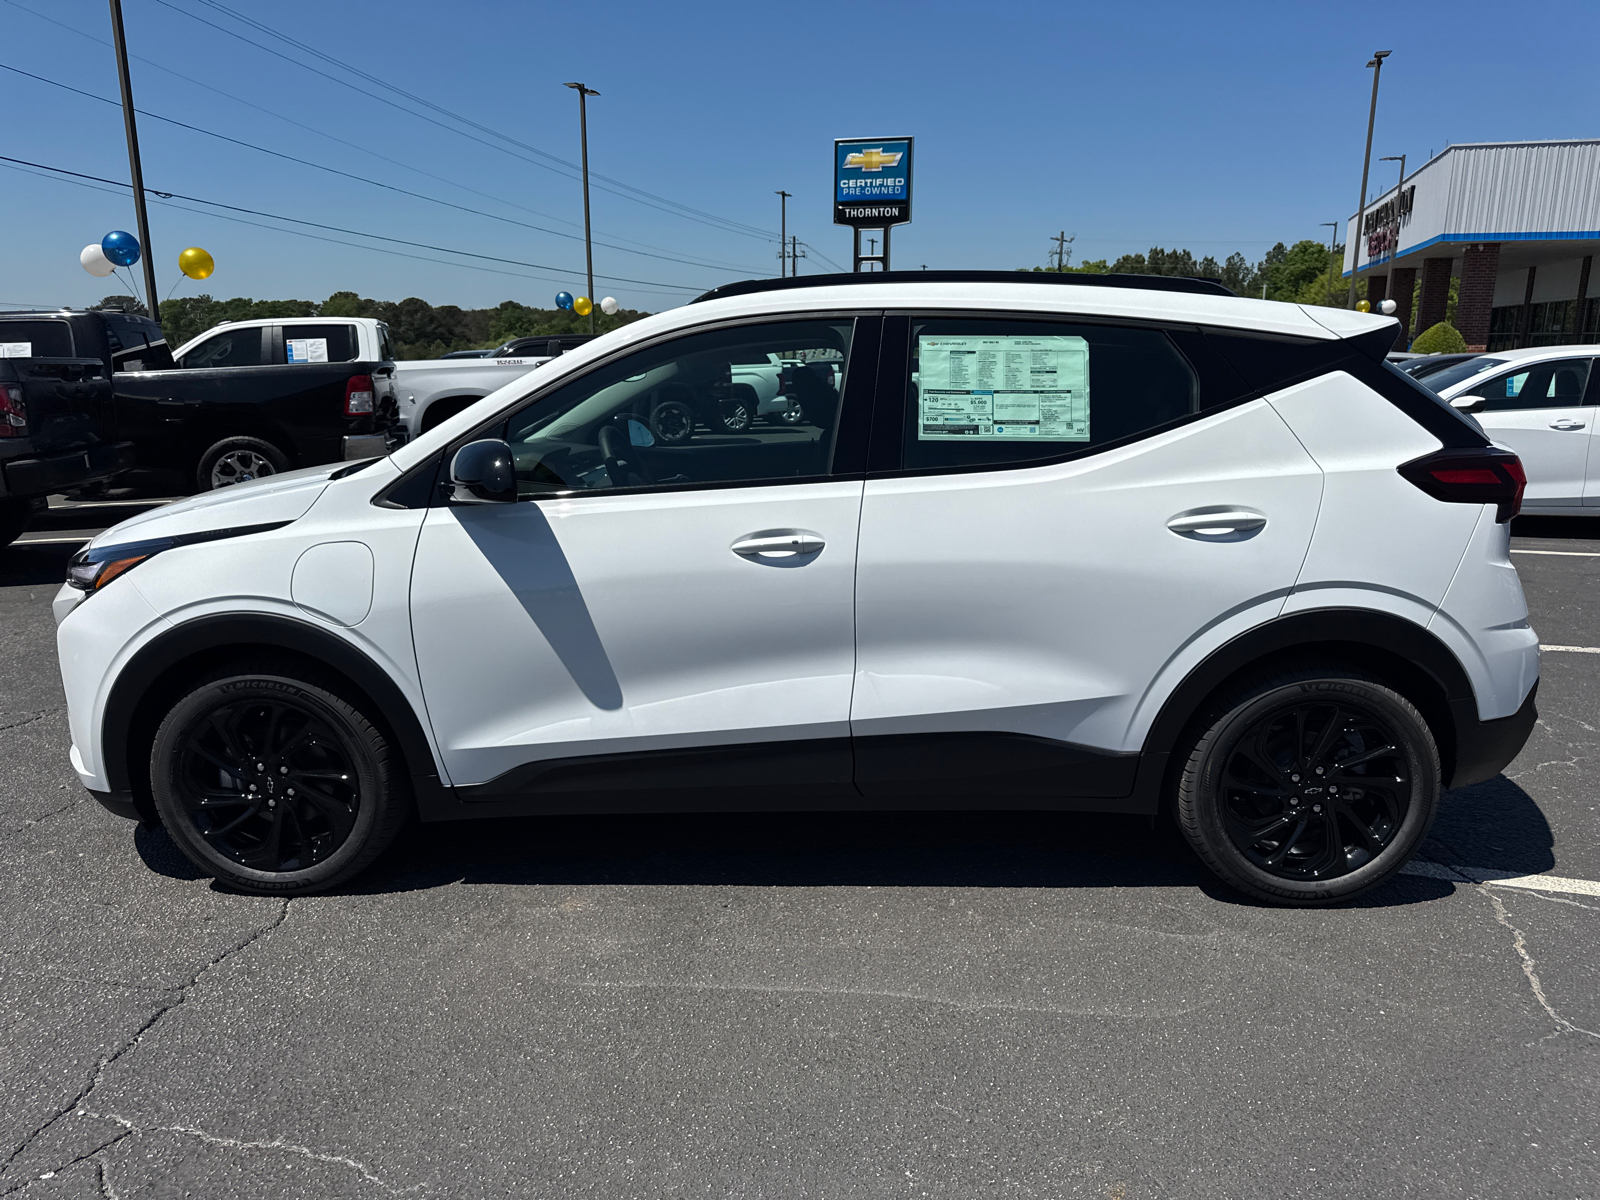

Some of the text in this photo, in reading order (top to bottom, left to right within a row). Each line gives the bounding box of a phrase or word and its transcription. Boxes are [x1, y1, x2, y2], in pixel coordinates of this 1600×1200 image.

[840, 178, 904, 188] CERTIFIED
[843, 186, 901, 195] PRE-OWNED
[845, 207, 899, 218] THORNTON
[236, 681, 296, 694] MICHELIN
[1318, 683, 1380, 702] MICHELIN
